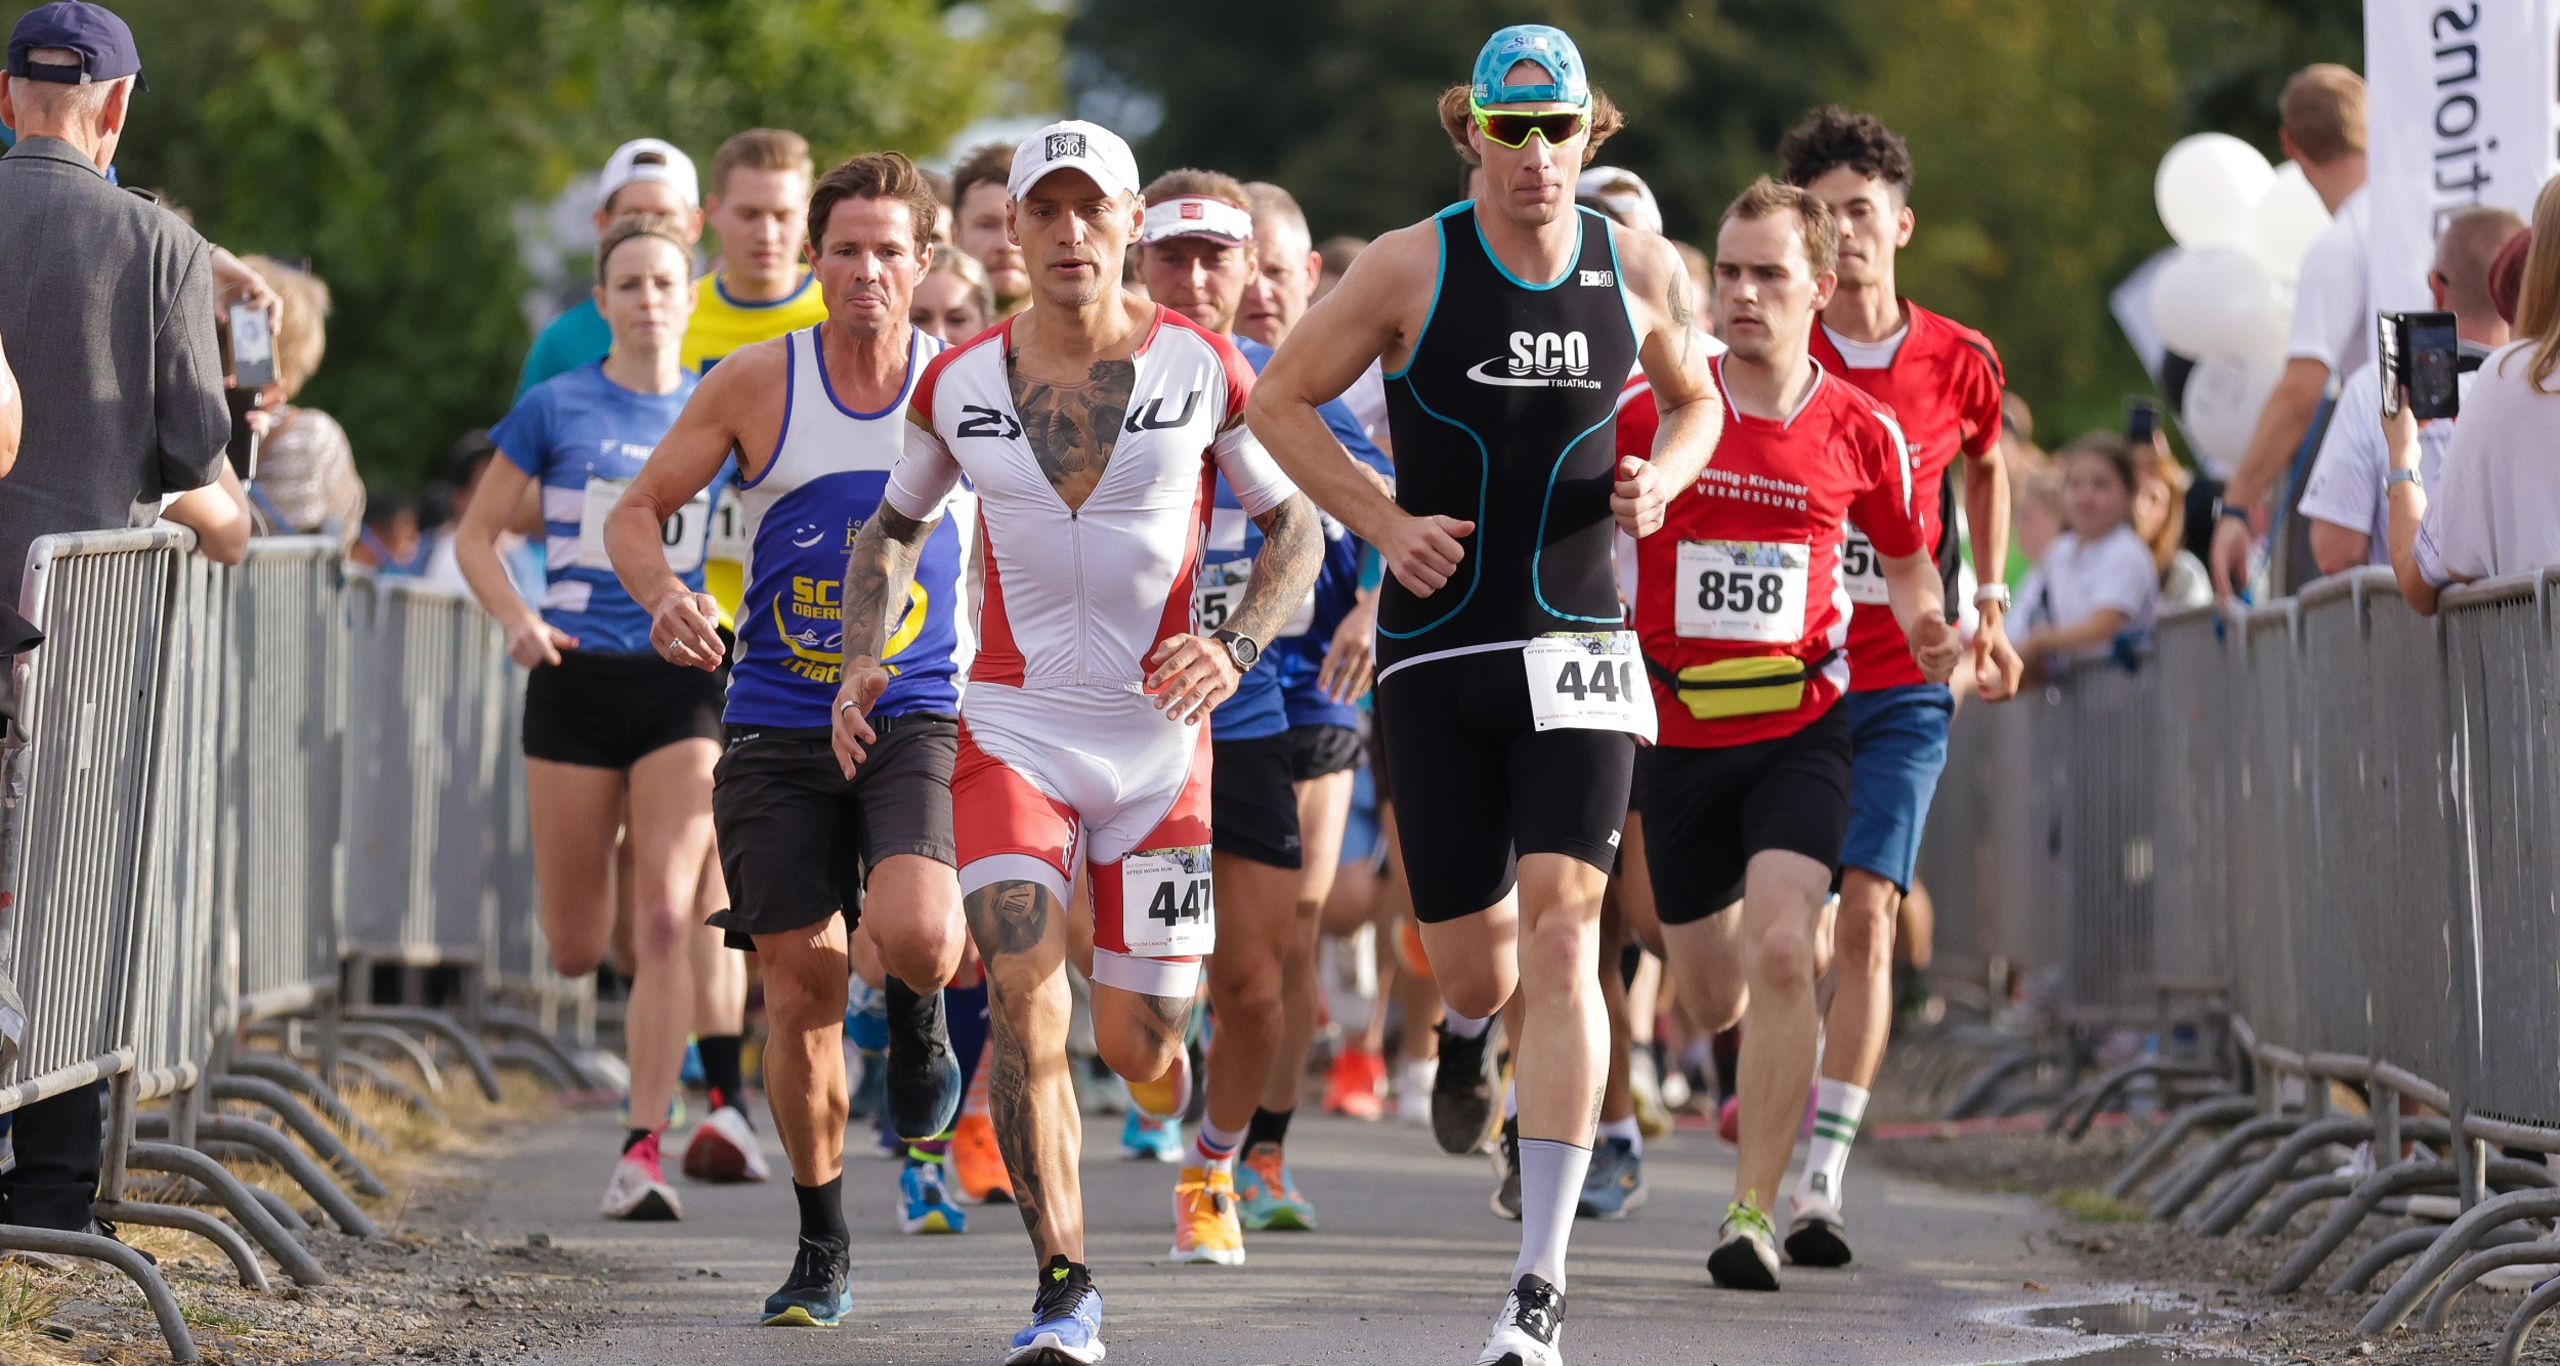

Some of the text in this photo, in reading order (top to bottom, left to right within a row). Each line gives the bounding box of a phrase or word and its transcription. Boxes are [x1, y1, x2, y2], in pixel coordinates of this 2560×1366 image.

[1508, 331, 1590, 376] SCO
[1550, 378, 1601, 390] TRIATHLON
[1697, 483, 1808, 511] VERMESSUNG
[1698, 570, 1784, 613] 858
[1149, 879, 1211, 927] 447
